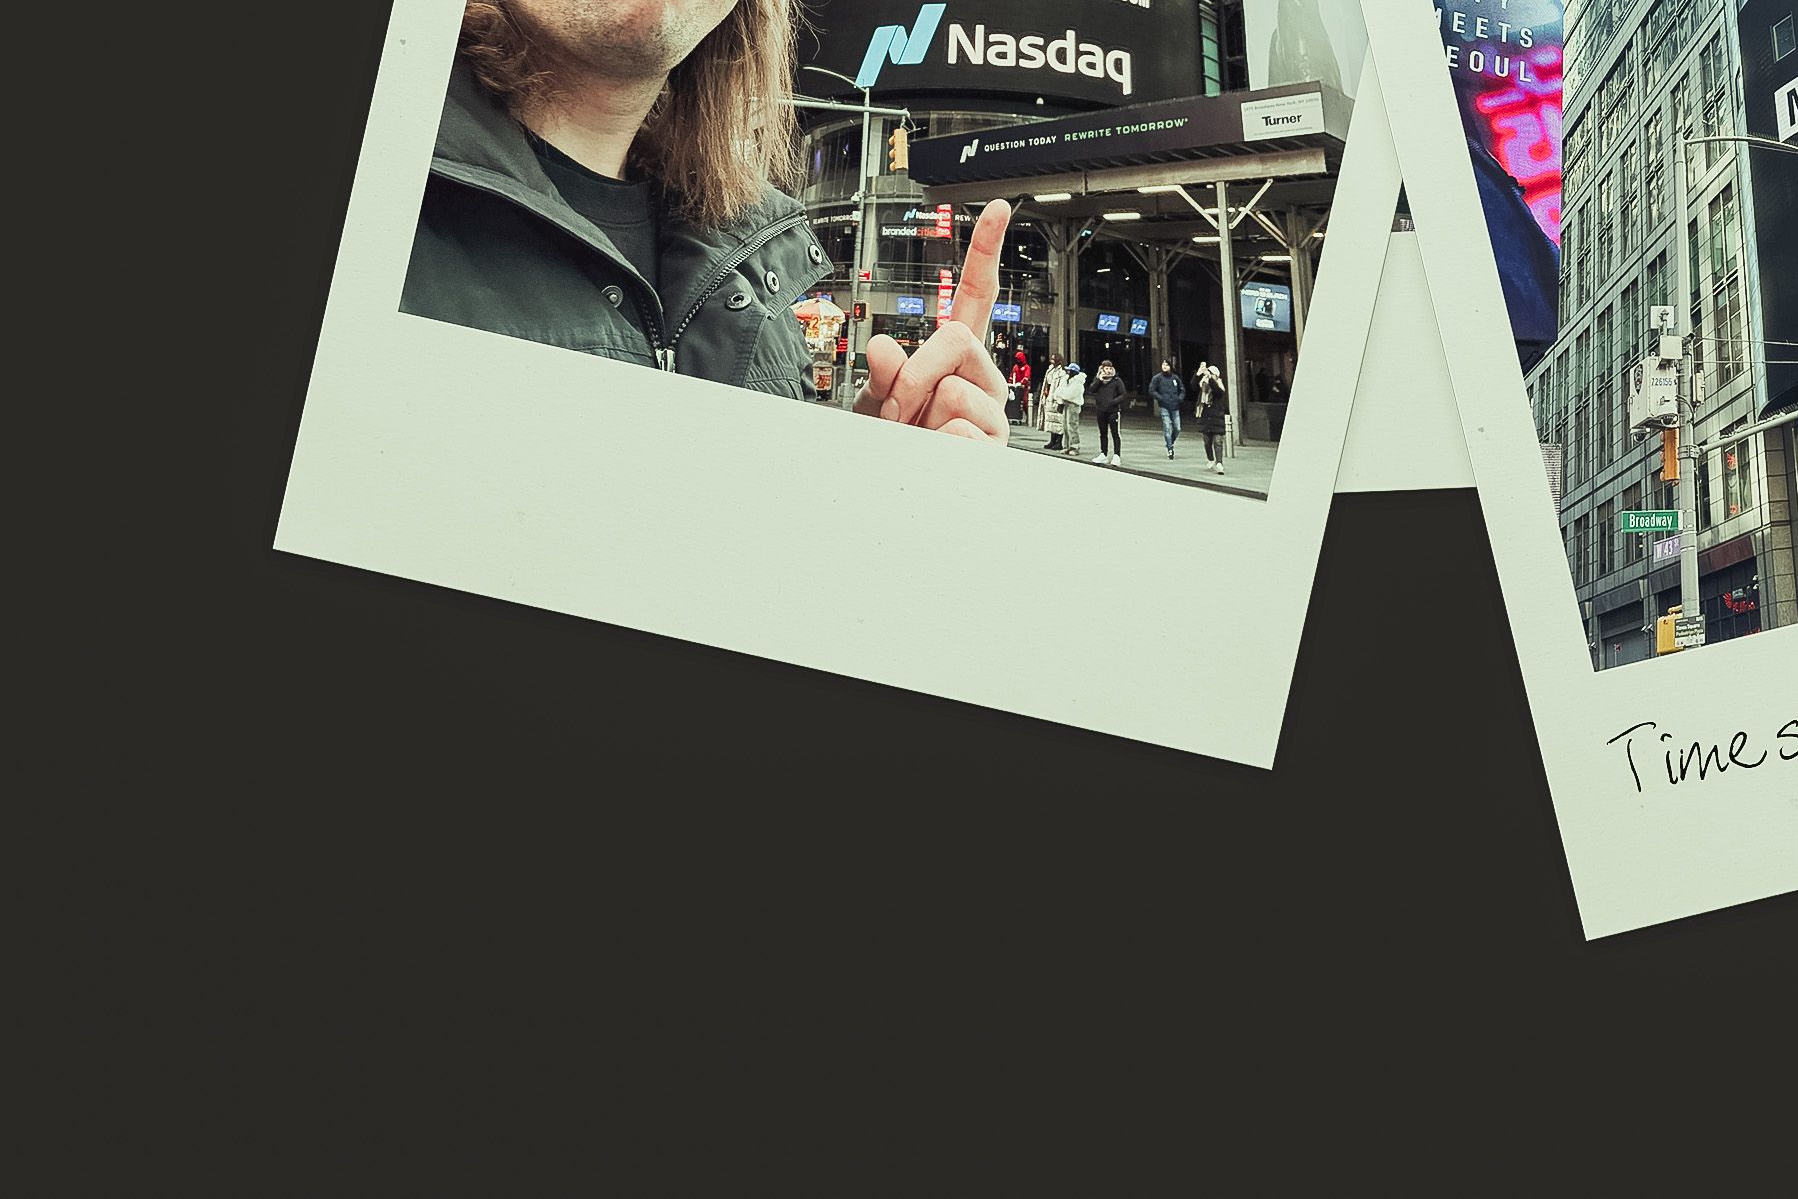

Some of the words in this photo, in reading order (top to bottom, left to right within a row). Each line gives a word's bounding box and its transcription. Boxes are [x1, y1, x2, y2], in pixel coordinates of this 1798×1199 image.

[947, 23, 1134, 96] Nasdaq
[1262, 114, 1302, 126] Turner
[984, 139, 1026, 152] QUESTION
[1028, 135, 1057, 147] TODAY
[1064, 128, 1112, 141] REWRITE
[1629, 513, 1673, 529] Broadway
[1663, 541, 1673, 556] 43
